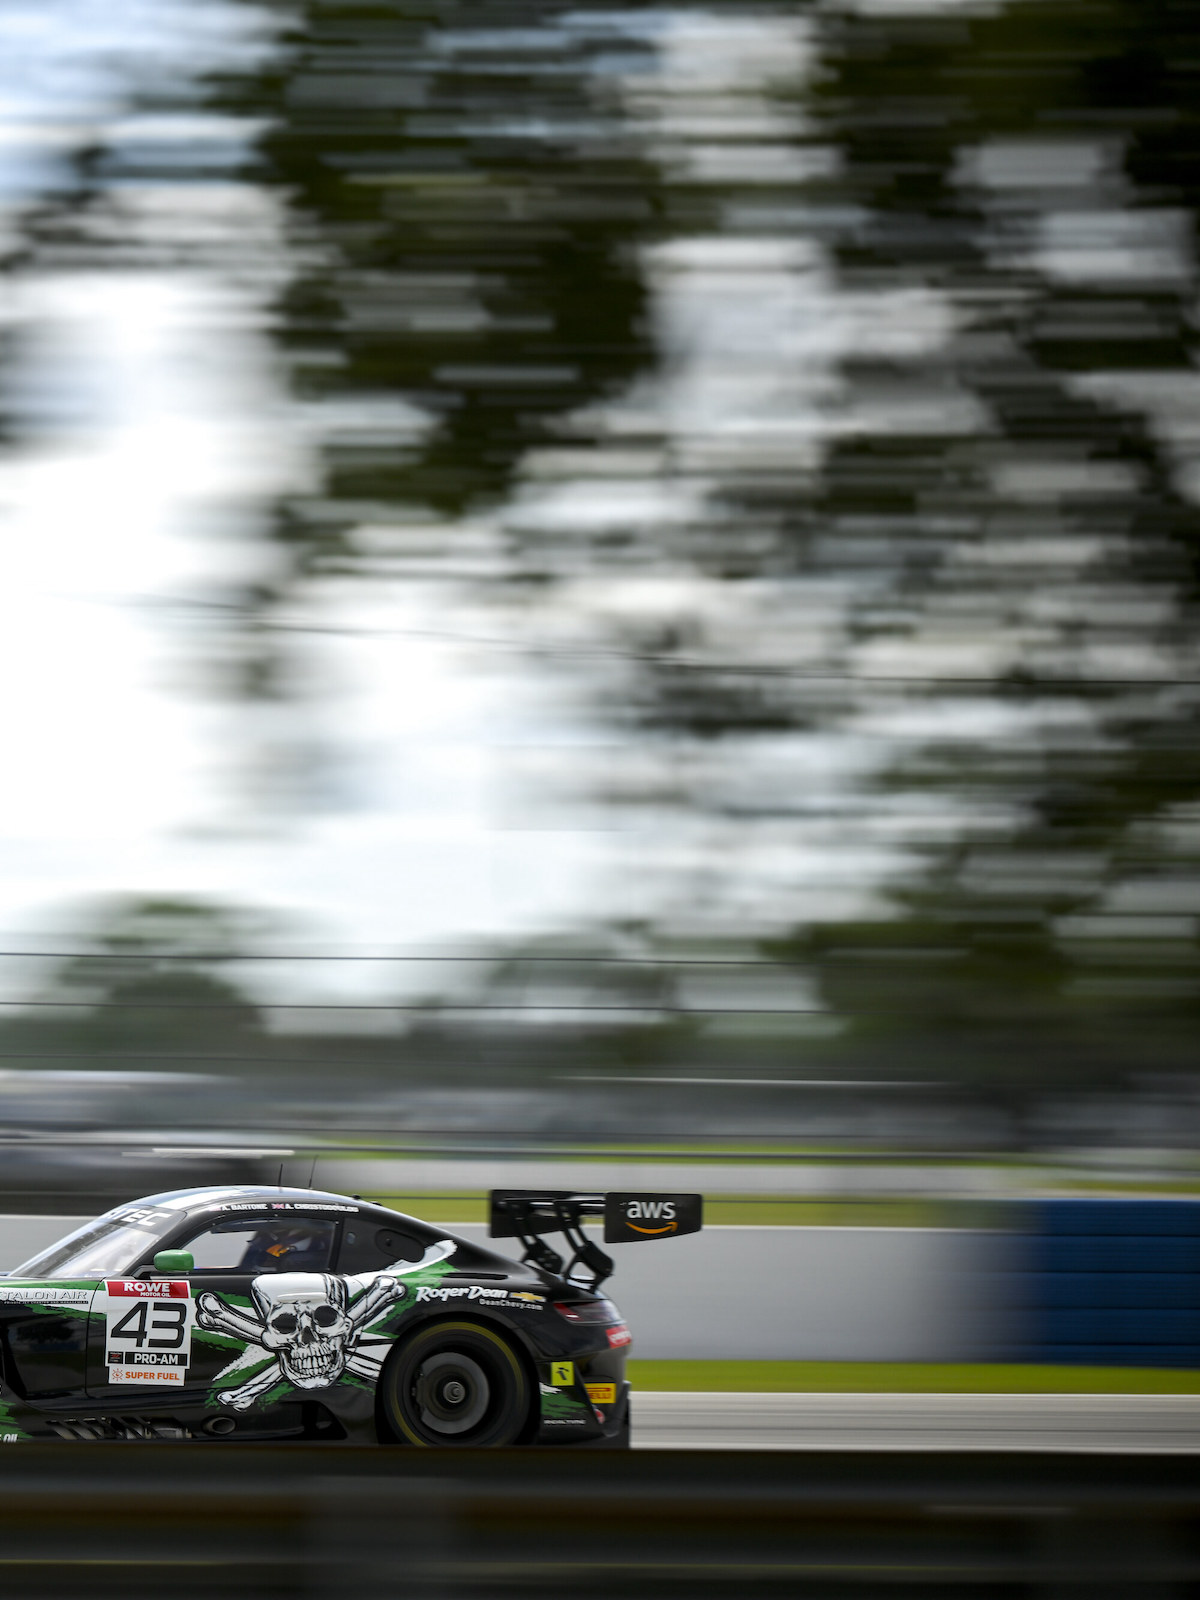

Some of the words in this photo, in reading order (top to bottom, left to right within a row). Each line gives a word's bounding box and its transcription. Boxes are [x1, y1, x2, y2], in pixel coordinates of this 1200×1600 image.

[627, 1201, 676, 1219] aws
[124, 1282, 171, 1292] ROWE
[59, 1291, 87, 1300] AIR
[416, 1286, 469, 1301] Roger
[467, 1286, 508, 1299] Dean
[479, 1299, 543, 1310] DeanChevy.com
[111, 1302, 187, 1348] 43
[134, 1353, 179, 1365] PRO-AM
[125, 1371, 155, 1380] SUPER
[157, 1372, 180, 1380] FUEL
